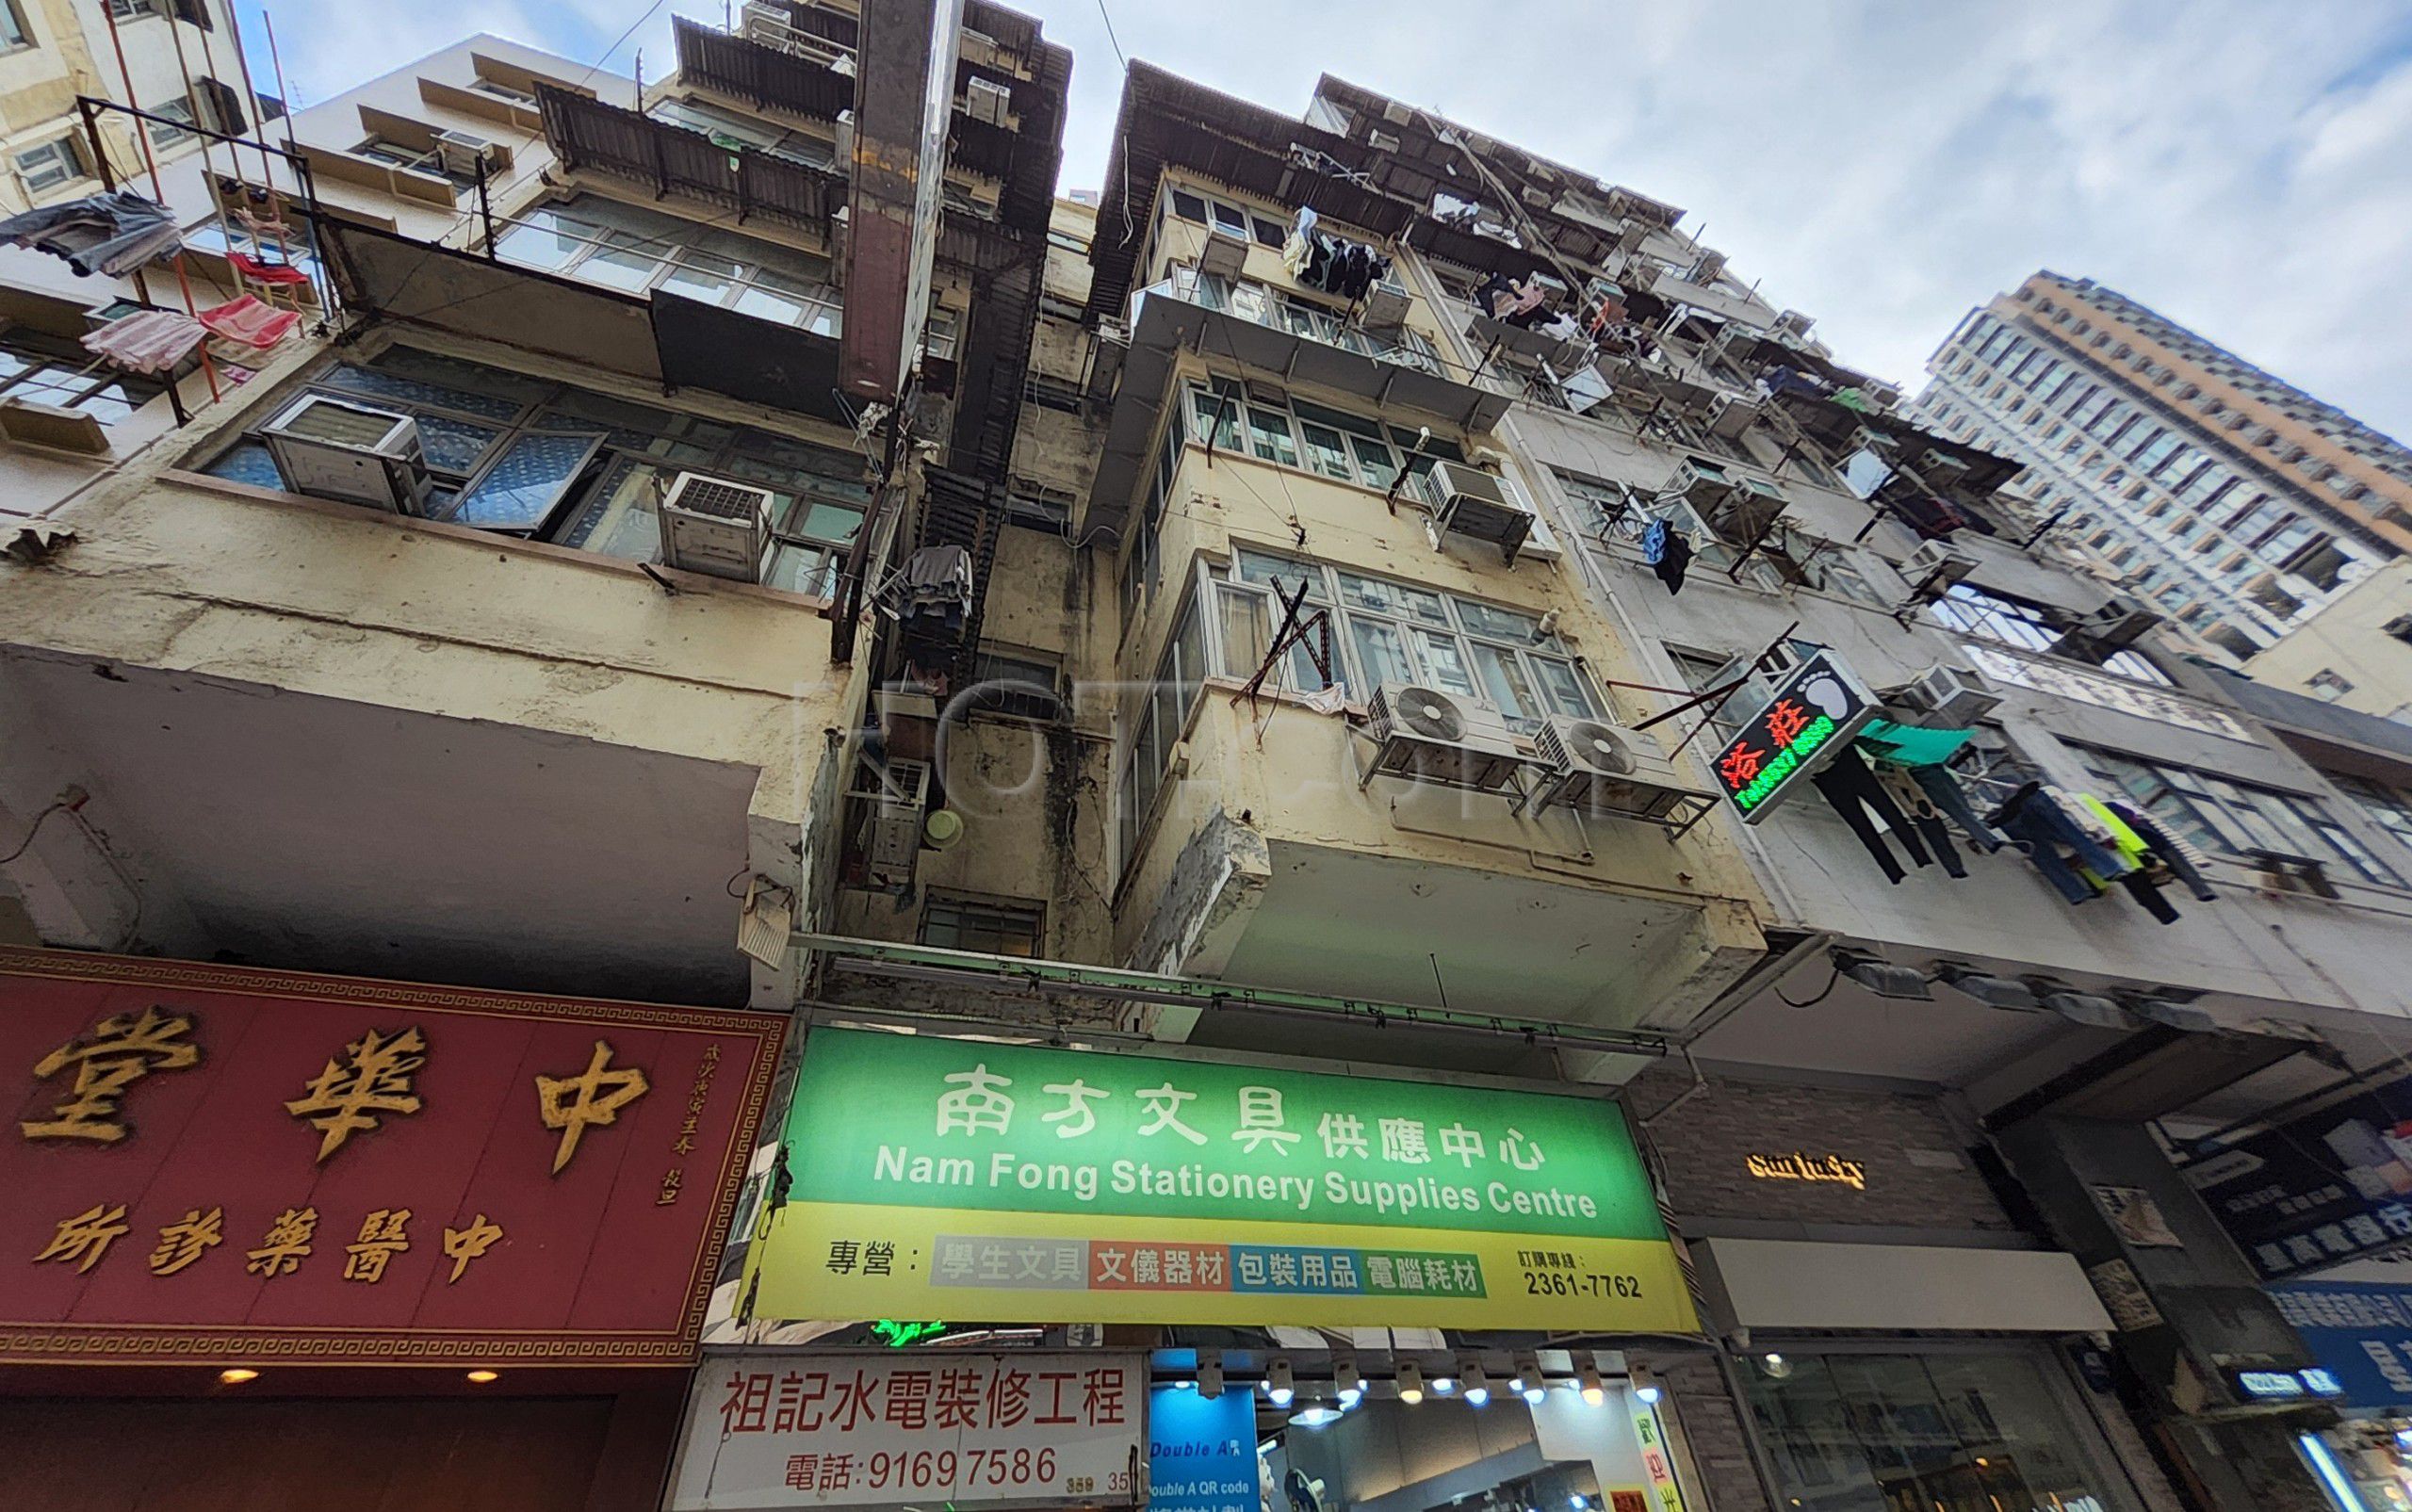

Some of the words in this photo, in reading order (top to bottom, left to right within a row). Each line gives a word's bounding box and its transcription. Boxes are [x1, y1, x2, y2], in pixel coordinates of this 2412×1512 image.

[937, 1063, 1545, 1171] 南方文具供應中心
[873, 1145, 974, 1186] Nam
[989, 1152, 1098, 1201] Fong
[1111, 1159, 1313, 1211] Stationery
[1324, 1171, 1481, 1215] Supplies
[1487, 1181, 1597, 1219] Centre
[31, 1203, 503, 1284] 中醫藥診所
[942, 1243, 1083, 1282] 學生文具
[1097, 1247, 1225, 1285] 文儀器材
[1238, 1251, 1359, 1289] 包裝用品
[1366, 1255, 1479, 1293] 電腦耗材
[1524, 1271, 1643, 1299] 2361-7762
[719, 1367, 1126, 1434] 祖記水電裝修工程
[1149, 1441, 1210, 1458] Double
[1149, 1482, 1185, 1497] ouble
[1187, 1481, 1198, 1496] A
[1198, 1480, 1218, 1496] QR
[1220, 1479, 1249, 1494] code
